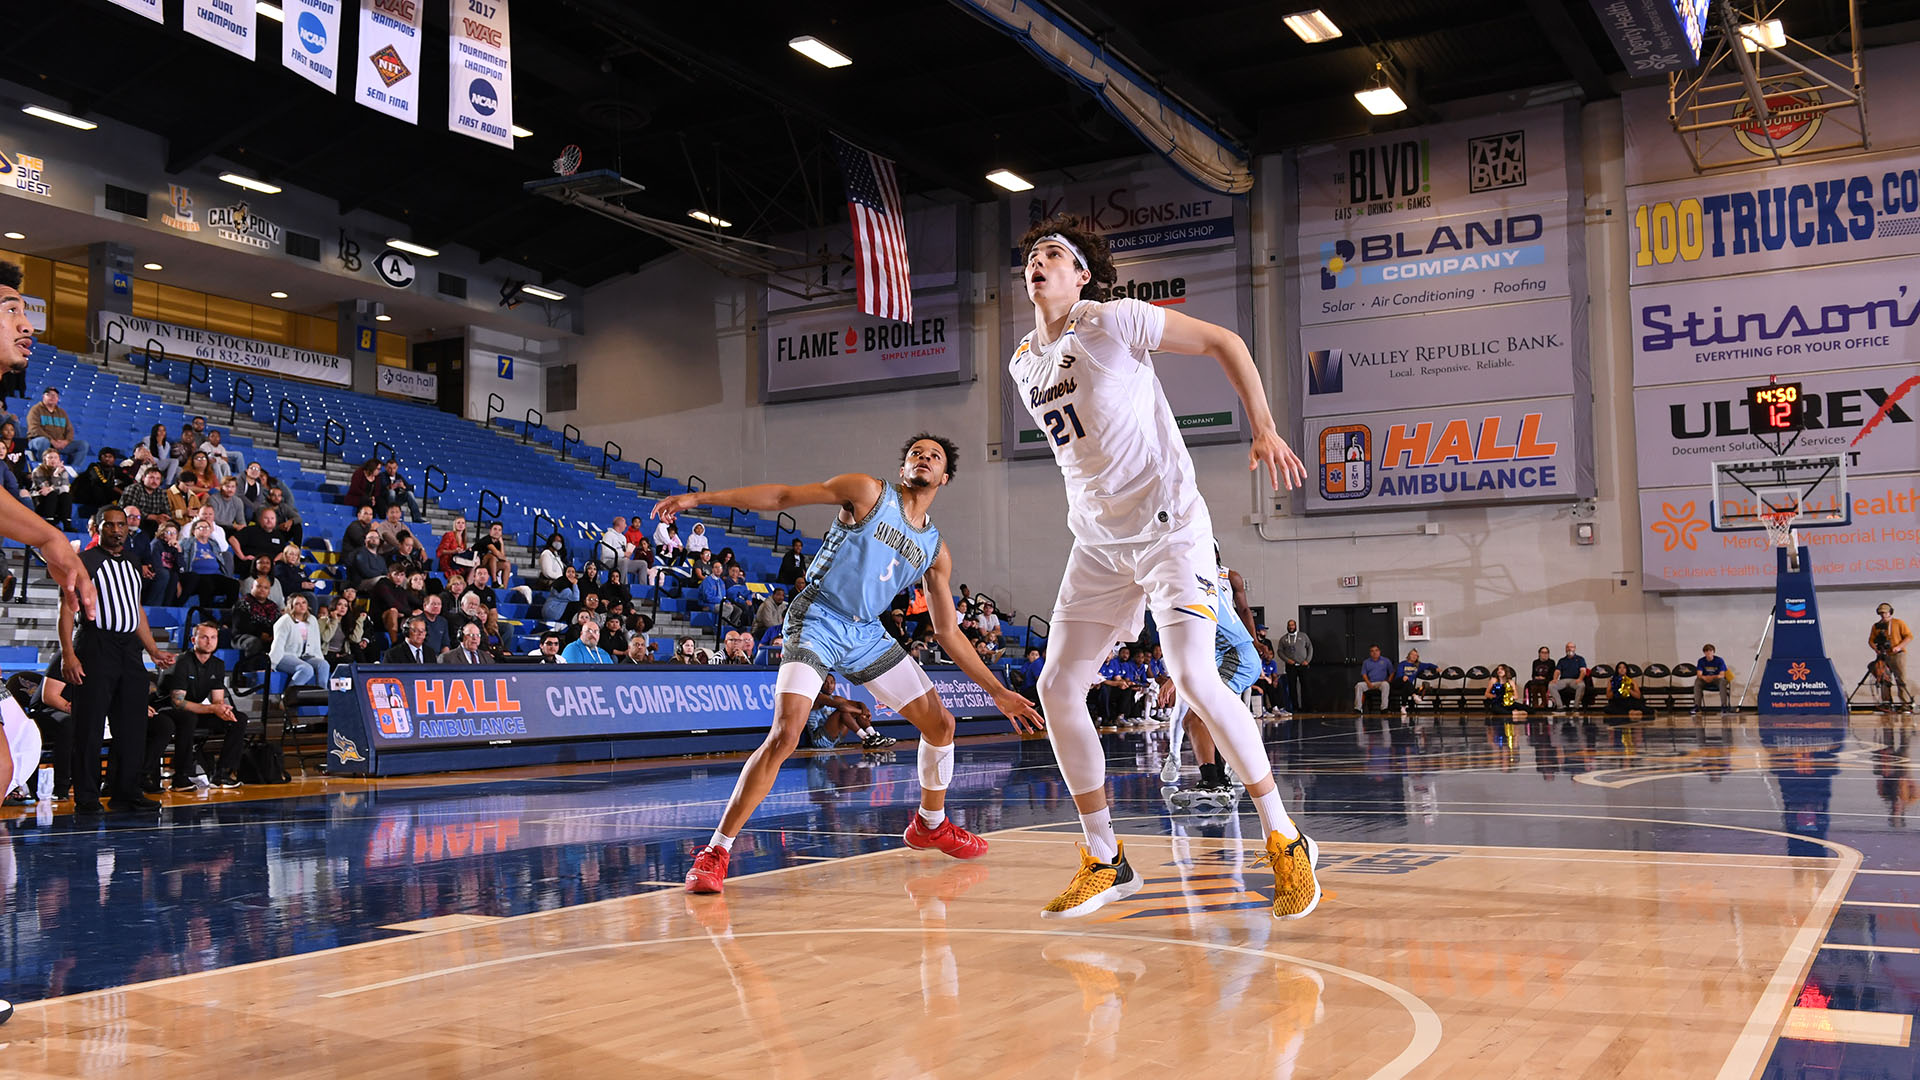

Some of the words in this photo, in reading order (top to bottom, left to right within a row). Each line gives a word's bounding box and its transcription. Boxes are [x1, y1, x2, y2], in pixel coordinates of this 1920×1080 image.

[298, 0, 334, 14] MPION
[374, 0, 415, 21] WAC
[469, 0, 496, 20] 2017
[197, 6, 248, 37] CHAMPIONS
[371, 11, 416, 38] CHAMPIONS
[462, 17, 502, 48] WAC
[300, 27, 327, 47] NCAA
[291, 48, 308, 66] FIRST
[309, 60, 333, 79] ROUND
[379, 60, 400, 75] NIT
[459, 42, 508, 69] TOURNAMENT
[464, 59, 503, 80] CHAMPION
[367, 87, 387, 103] SEMI
[389, 95, 409, 111] FINAL
[471, 93, 498, 110] NCAA
[458, 115, 479, 129] FIRST
[481, 121, 507, 138] ROUND
[16, 153, 44, 172] THE
[17, 166, 40, 181] BIG
[1350, 139, 1431, 204] BLVD!
[16, 179, 51, 196] WEST
[1333, 173, 1345, 184] THE
[1335, 208, 1352, 221] EATS
[1367, 200, 1393, 216] DRINKS
[1408, 196, 1431, 210] GAMES
[1635, 169, 1920, 267] 100TRUCKS.CO
[208, 208, 234, 227] CAL
[249, 215, 280, 242] POLY
[1116, 237, 1137, 249] ONE
[1138, 233, 1163, 246] STOP
[1164, 230, 1186, 242] SIGN
[1188, 225, 1214, 241] SHOP
[219, 230, 270, 249] MUSTANGS
[1361, 214, 1543, 262] BLAND
[1382, 250, 1521, 281] COMPANY
[115, 278, 127, 289] GA
[1101, 277, 1186, 302] estone
[1322, 302, 1355, 314] Solar
[1371, 296, 1390, 308] Air
[1393, 288, 1475, 306] Conditioning
[1493, 278, 1547, 295] Roofing
[1642, 285, 1920, 352] Stinson'
[119, 315, 151, 334] NOW
[157, 324, 171, 338] IN
[175, 326, 203, 345] THE
[207, 332, 290, 360] STOCKDALE
[293, 350, 340, 370] TOWER
[361, 329, 372, 349] 8
[777, 331, 839, 362] FLAME
[864, 318, 946, 351] BROILER
[1349, 349, 1409, 367] VALLEY
[1416, 340, 1500, 361] REPUBLIC
[1506, 334, 1560, 352] BANK
[1695, 346, 1773, 363] EVERYTHING
[1776, 344, 1801, 355] FOR
[1805, 340, 1841, 353] YOUR
[1845, 335, 1889, 348] OFFICE
[195, 345, 216, 359] 661
[219, 348, 270, 369] 832-5200
[881, 351, 909, 361] SIMPLY
[911, 347, 947, 359] HEALTHY
[395, 372, 414, 385] don
[417, 374, 434, 387] hall
[501, 358, 510, 377] 7
[1390, 369, 1415, 378] Local.
[1421, 363, 1471, 377] Responsive.
[1476, 358, 1515, 370] Reliable.
[1030, 377, 1077, 409] Runners
[1756, 386, 1797, 404] 14:50
[1044, 402, 1087, 447] 21
[1183, 417, 1214, 425] COMPANY
[1670, 387, 1914, 440] ULREX
[1769, 402, 1791, 428] 12
[1380, 412, 1559, 471] HALL
[1672, 443, 1726, 456] Document
[1801, 436, 1847, 447] Services
[1378, 466, 1557, 497] AMBULANCE
[1723, 535, 1770, 552] Mercy
[1797, 529, 1875, 547] Memorial
[1664, 565, 1717, 579] Exclusive
[1721, 564, 1761, 578] Health
[1850, 559, 1862, 572] of
[1866, 557, 1906, 572] CSUB
[414, 677, 521, 717] HALL
[934, 680, 954, 693] deline
[1774, 682, 1801, 691] Dignity
[546, 686, 616, 718] CARE,
[615, 684, 744, 714] COMPASSION
[745, 690, 759, 711] &
[964, 694, 985, 708] CSUB
[418, 715, 527, 738] AMBULANCE
